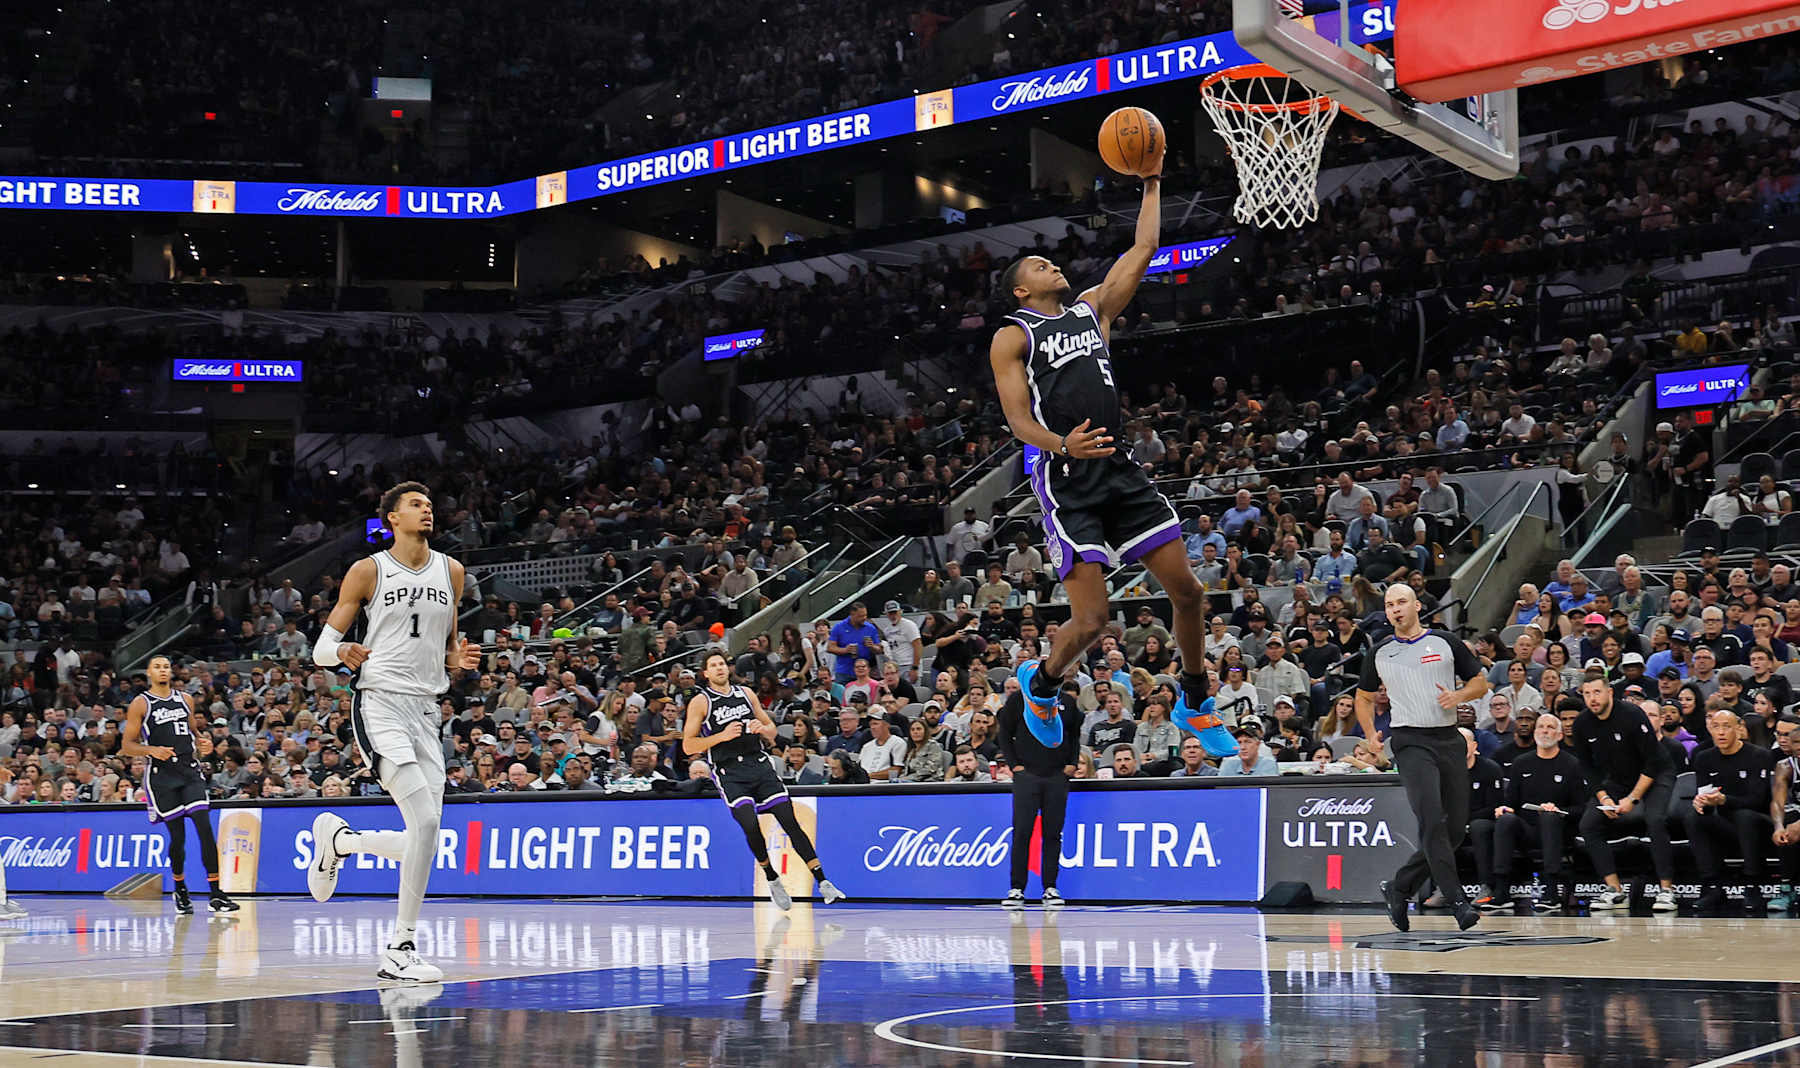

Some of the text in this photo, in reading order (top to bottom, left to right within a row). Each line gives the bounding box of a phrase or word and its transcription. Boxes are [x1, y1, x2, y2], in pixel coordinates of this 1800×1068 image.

[1576, 41, 1691, 71] State
[992, 41, 1222, 111] Michelob ULTRA
[597, 114, 871, 190] SUPERIOR LIGHT BEER
[65, 182, 140, 205] BEER
[277, 188, 503, 213] Michelob ULTRA
[1181, 244, 1227, 261] ULTR
[1039, 329, 1103, 368] Kings
[243, 364, 296, 377] ULTRA
[1096, 358, 1114, 387] 5
[384, 587, 449, 608] SPURS
[410, 613, 420, 637] 1
[712, 704, 751, 725] Kings
[173, 721, 189, 735] 13
[1298, 798, 1375, 817] Michelob
[1283, 821, 1395, 848] ULTRA
[489, 827, 600, 869] LIGHT
[611, 825, 711, 869] BEER
[864, 825, 1013, 873] Michelob
[1645, 884, 1702, 893] BACODE
